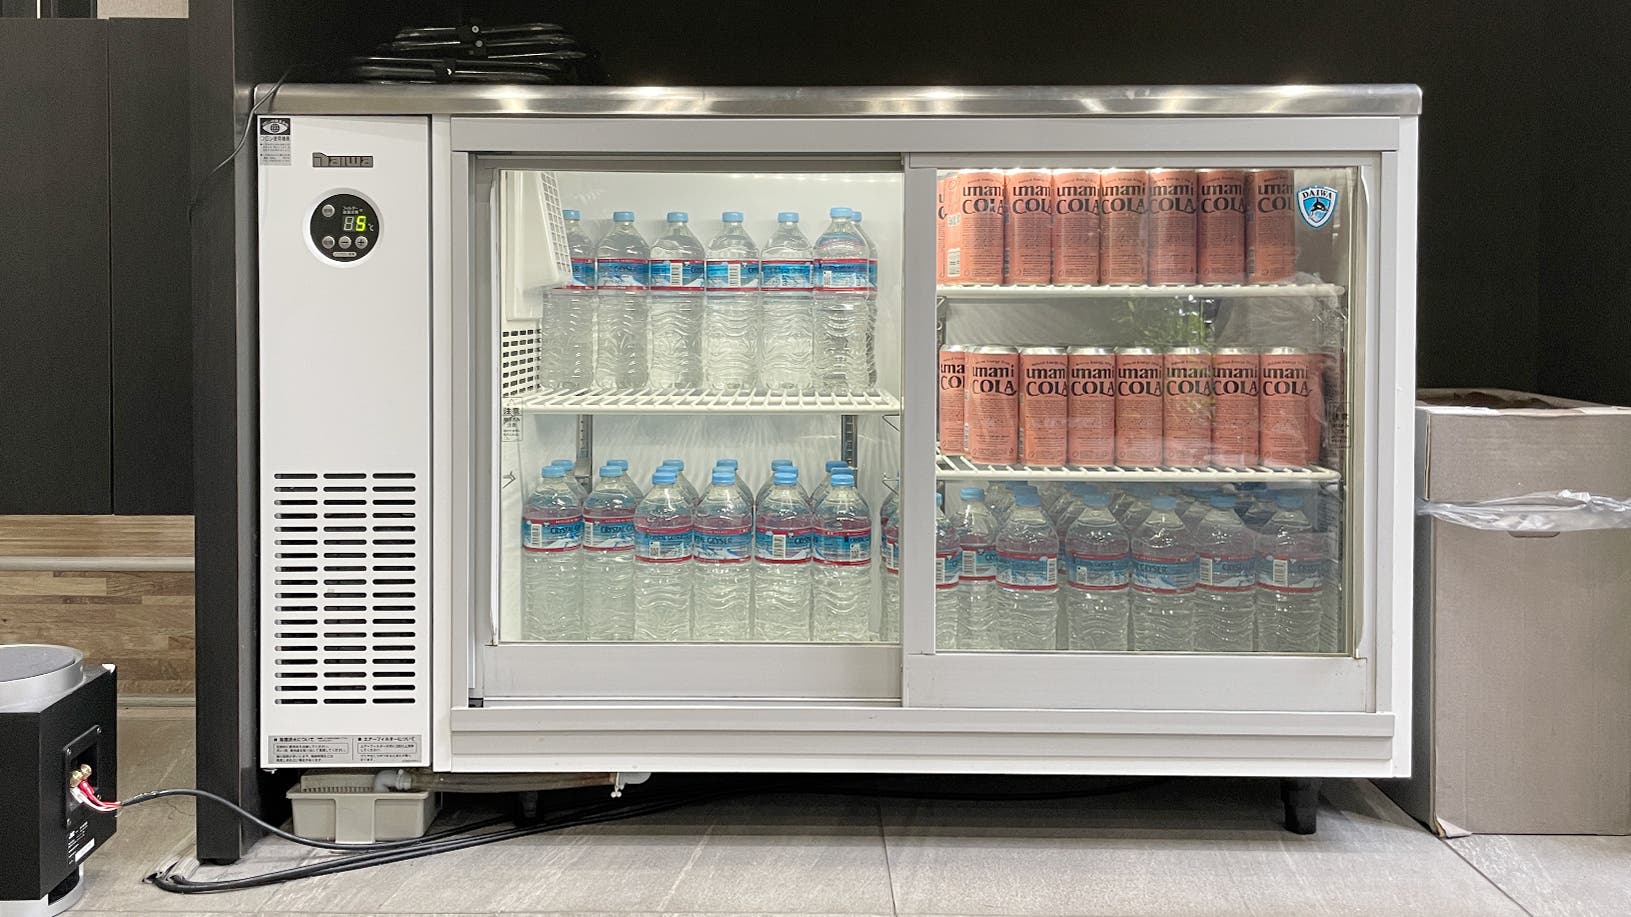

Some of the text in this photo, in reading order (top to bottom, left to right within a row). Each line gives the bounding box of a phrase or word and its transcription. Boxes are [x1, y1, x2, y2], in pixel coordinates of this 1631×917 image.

[1301, 188, 1333, 200] DAIWA
[1101, 198, 1148, 214] COLA
[1263, 365, 1309, 379] umani
[972, 379, 1017, 396] COLA
[1071, 380, 1116, 397] COLA
[1118, 380, 1162, 397] COLA
[1166, 380, 1211, 397] COLA
[1213, 380, 1259, 397] COLA
[1263, 380, 1313, 397] COLA
